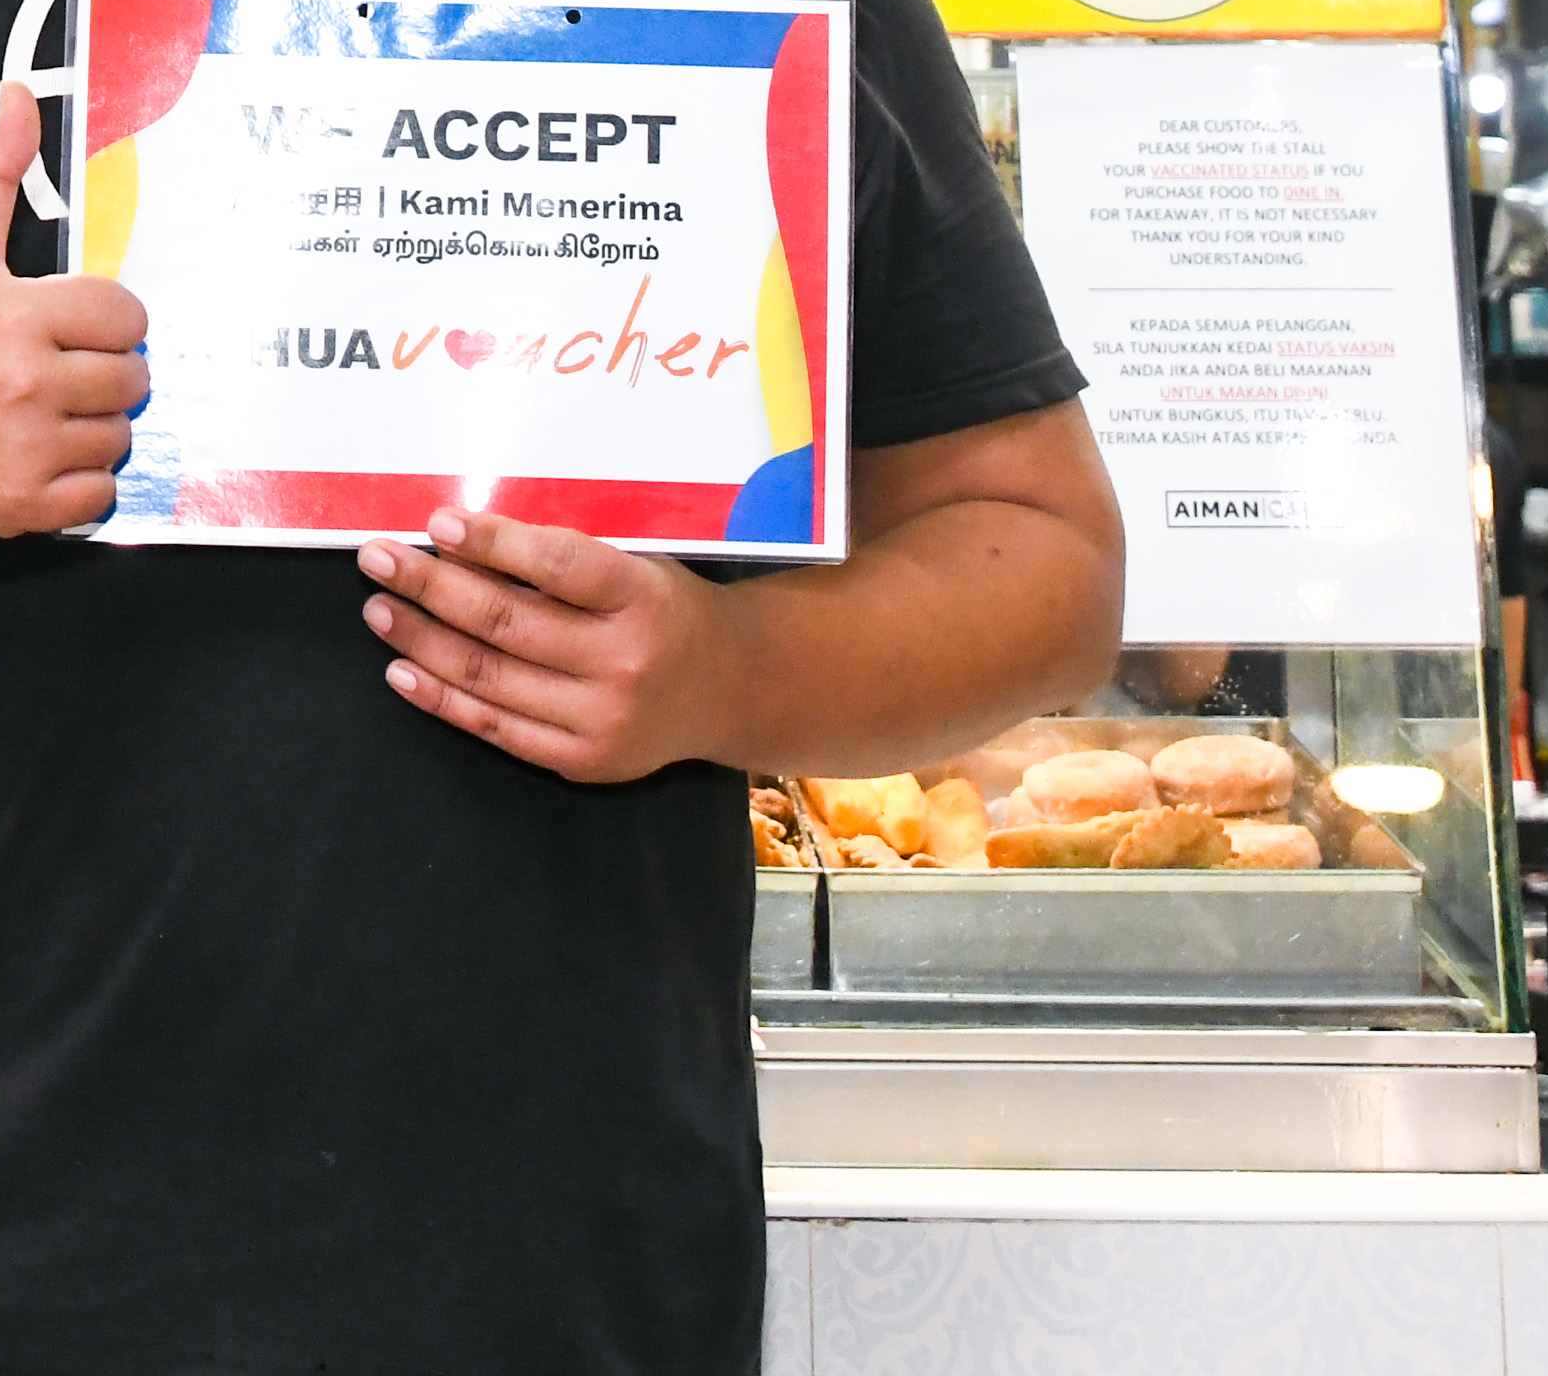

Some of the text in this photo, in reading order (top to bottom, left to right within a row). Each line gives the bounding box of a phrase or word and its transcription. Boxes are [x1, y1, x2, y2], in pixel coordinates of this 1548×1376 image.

[1159, 119, 1199, 132] DEAR
[382, 109, 677, 164] ACCEPT
[1138, 141, 1191, 154] PLEASE
[1196, 141, 1244, 154] SHOW
[1283, 142, 1327, 155] STALL
[1103, 164, 1363, 178] YOUR VACCINATED STATUS IF YOU
[1125, 186, 1203, 198] PURCHASE
[1210, 186, 1253, 198] FOOD
[1259, 186, 1279, 198] TO
[1284, 186, 1319, 199] DINE
[400, 189, 489, 218] Kami
[503, 191, 683, 222] Menerima
[1090, 208, 1120, 220] FOR
[1125, 208, 1214, 222] TAKEAWAY,
[1219, 208, 1231, 220] IT
[1237, 208, 1249, 220] IS
[1254, 208, 1286, 220] NOT
[1131, 230, 1345, 242] THANK YOU FOR YOUR KIND
[1169, 252, 1308, 265] UNDERSTANDING.
[1130, 319, 1356, 333] KEPADA SEMUA PELANGGAN,
[1093, 341, 1395, 355] SILA TUNJUKKAN KEDAI STATUS VAKSIN
[1120, 364, 1371, 376] ANDA JIKA ANDA BELI MAKANAN
[1160, 386, 1214, 399] UNTUK
[1219, 386, 1277, 399] MAKAN
[1109, 408, 1163, 421] UNTUK
[1168, 408, 1249, 423] BUNGKUS,
[1254, 408, 1279, 421] ITU
[1097, 431, 1157, 444] TERIMA
[1162, 431, 1206, 444] KASIH
[1212, 431, 1251, 444] ATAS
[1174, 500, 1259, 518] AIMAN
